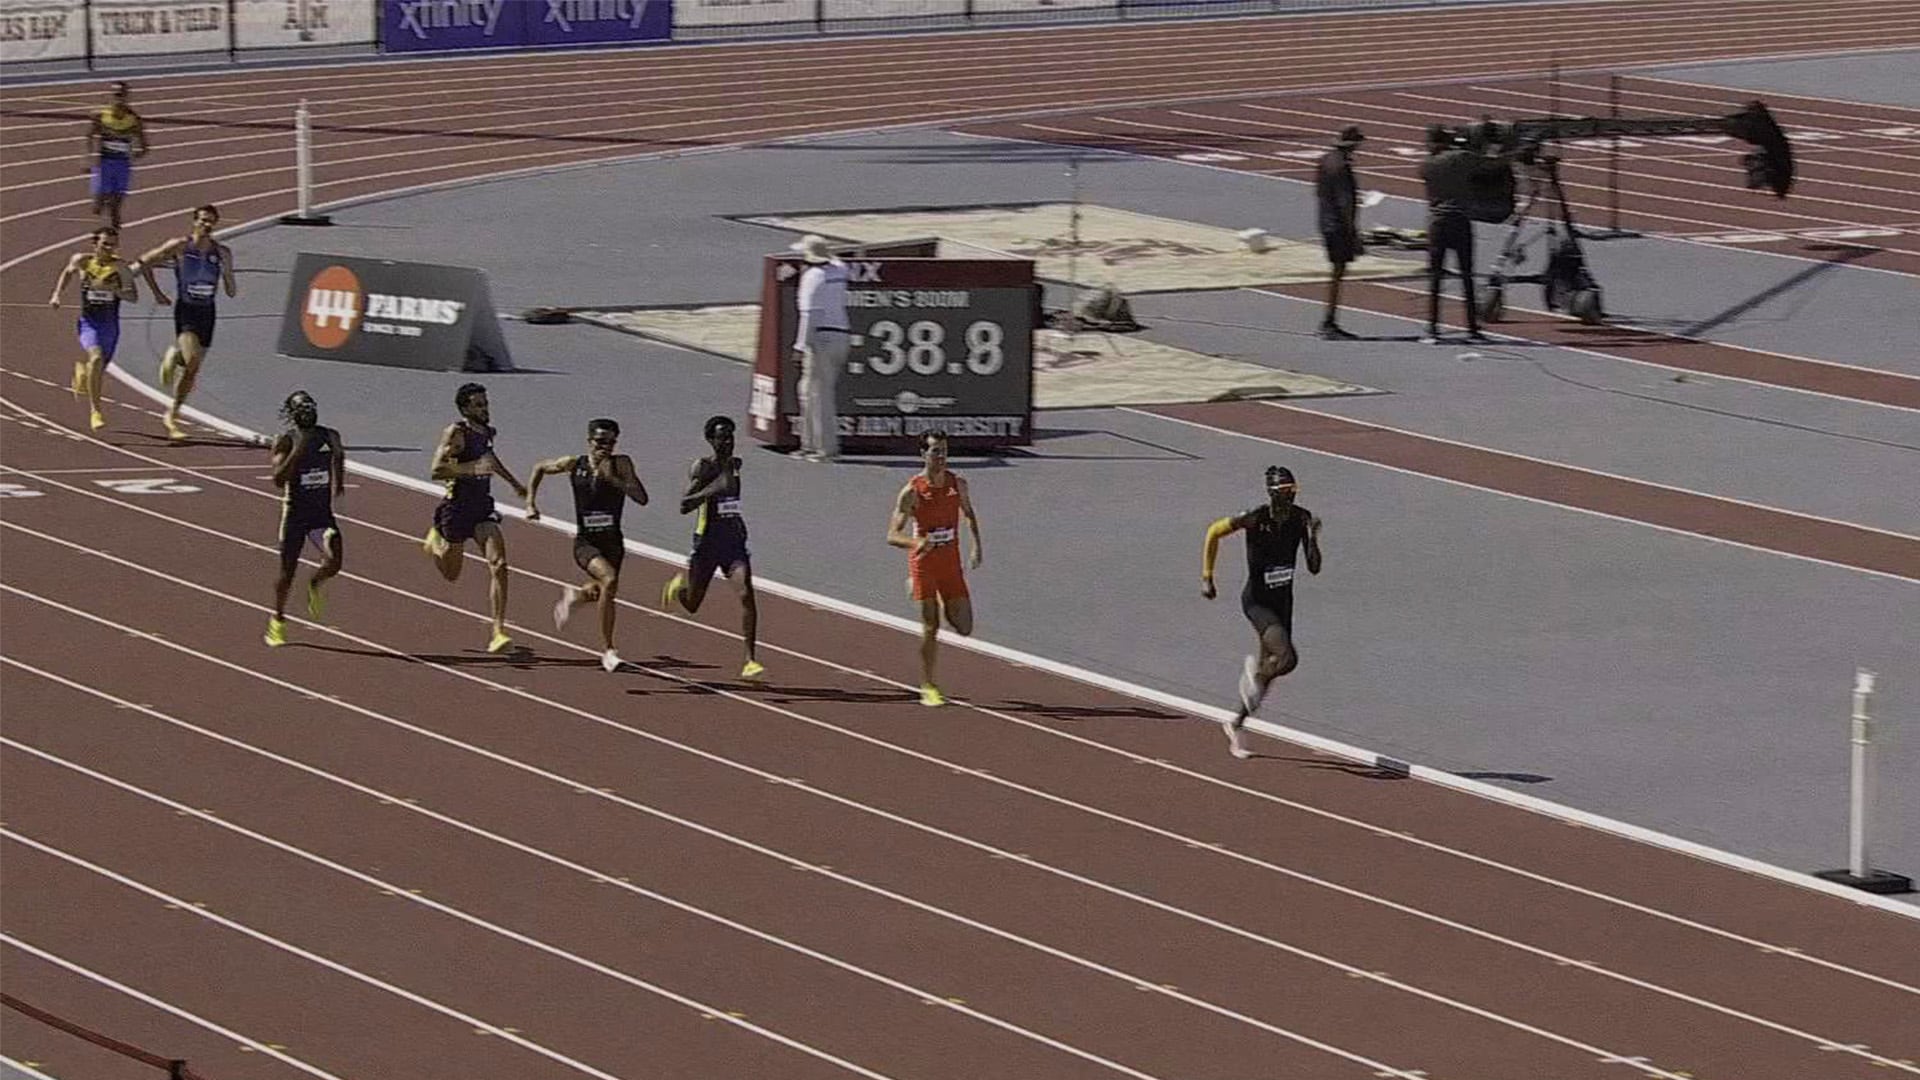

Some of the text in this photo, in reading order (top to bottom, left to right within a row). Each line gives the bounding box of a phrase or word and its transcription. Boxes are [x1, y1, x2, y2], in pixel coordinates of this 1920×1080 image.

[100, 10, 156, 36] TRACK
[173, 6, 219, 33] FIELD
[399, 0, 502, 39] xfinity
[306, 287, 467, 331] 44 FARMS
[904, 415, 1026, 437] UNIVERSITY
